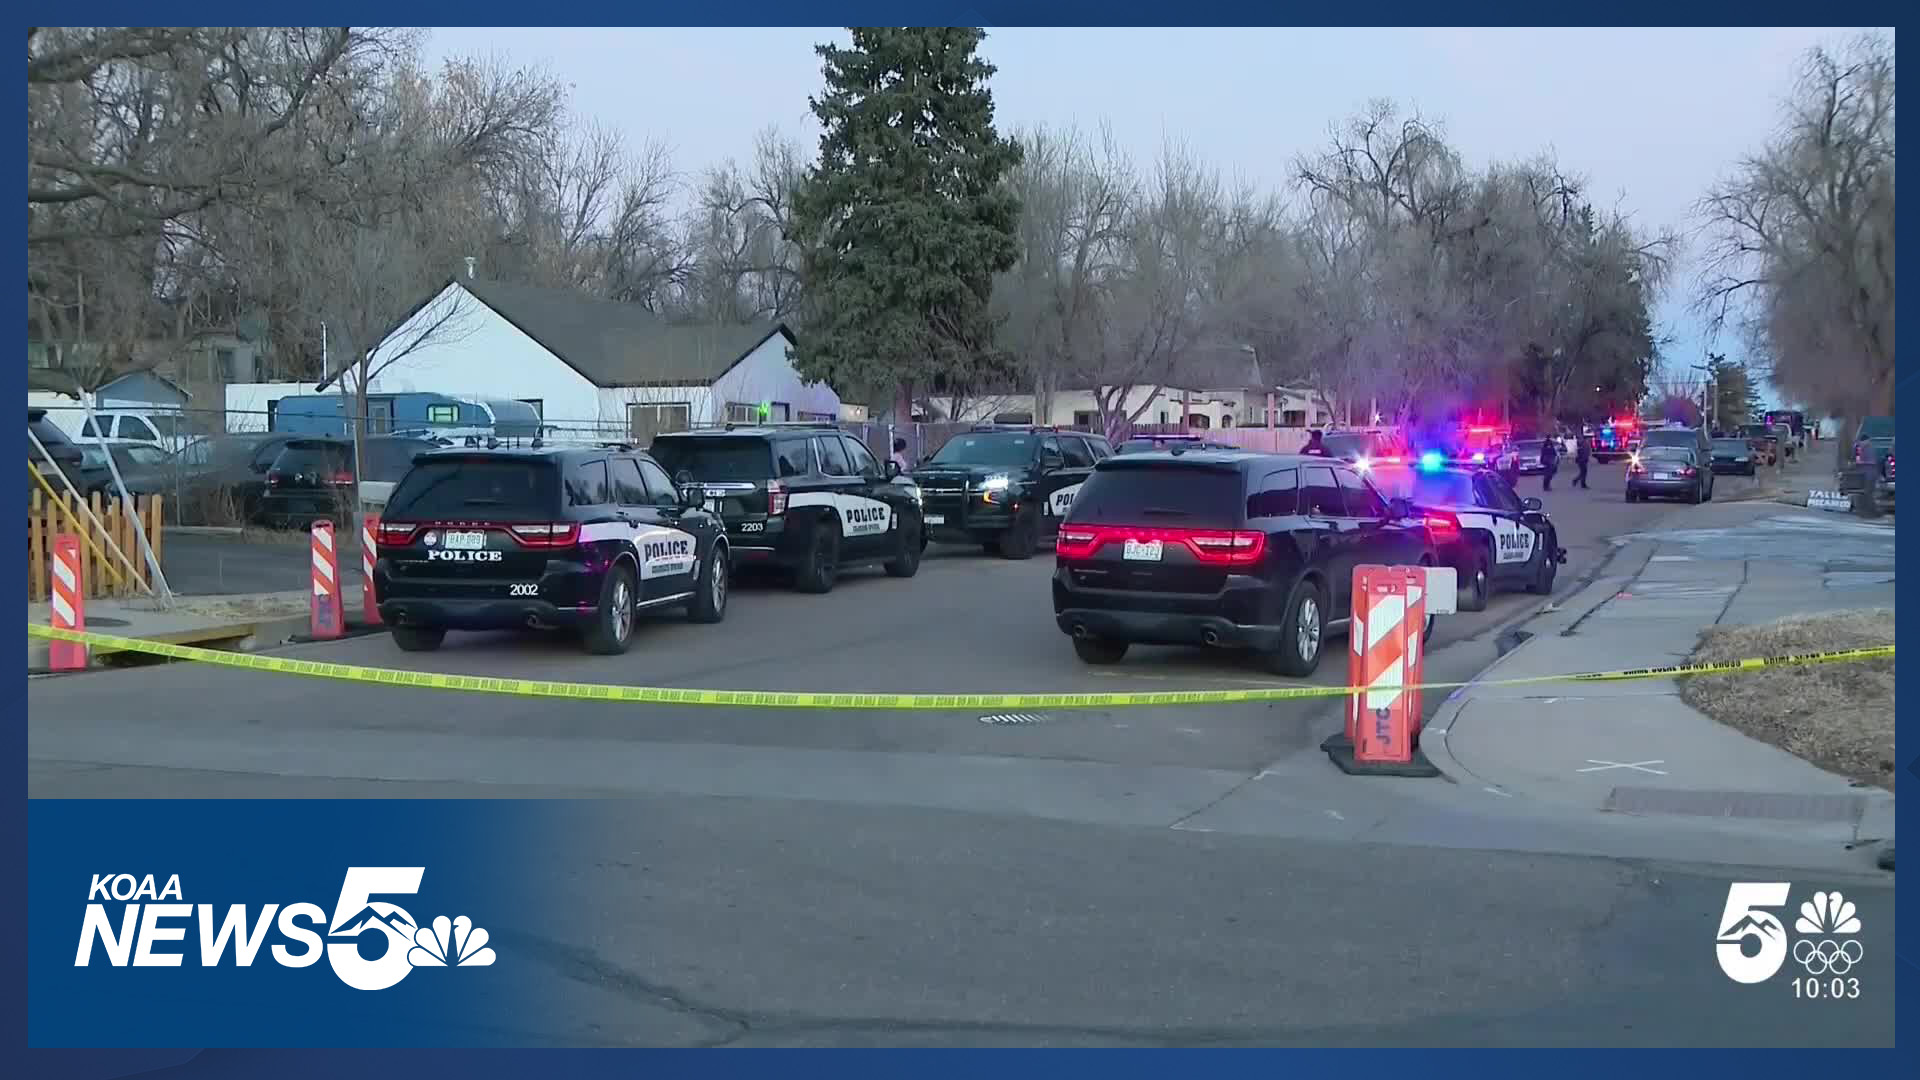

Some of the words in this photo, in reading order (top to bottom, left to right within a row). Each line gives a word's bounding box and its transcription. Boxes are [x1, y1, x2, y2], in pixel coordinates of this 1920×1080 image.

[846, 507, 885, 523] POLICE
[741, 522, 764, 532] 2203
[1500, 533, 1529, 550] POLICE
[428, 550, 502, 561] POLICE
[644, 541, 688, 561] POLICE
[510, 584, 539, 596] 2002
[1375, 706, 1391, 746] JTC
